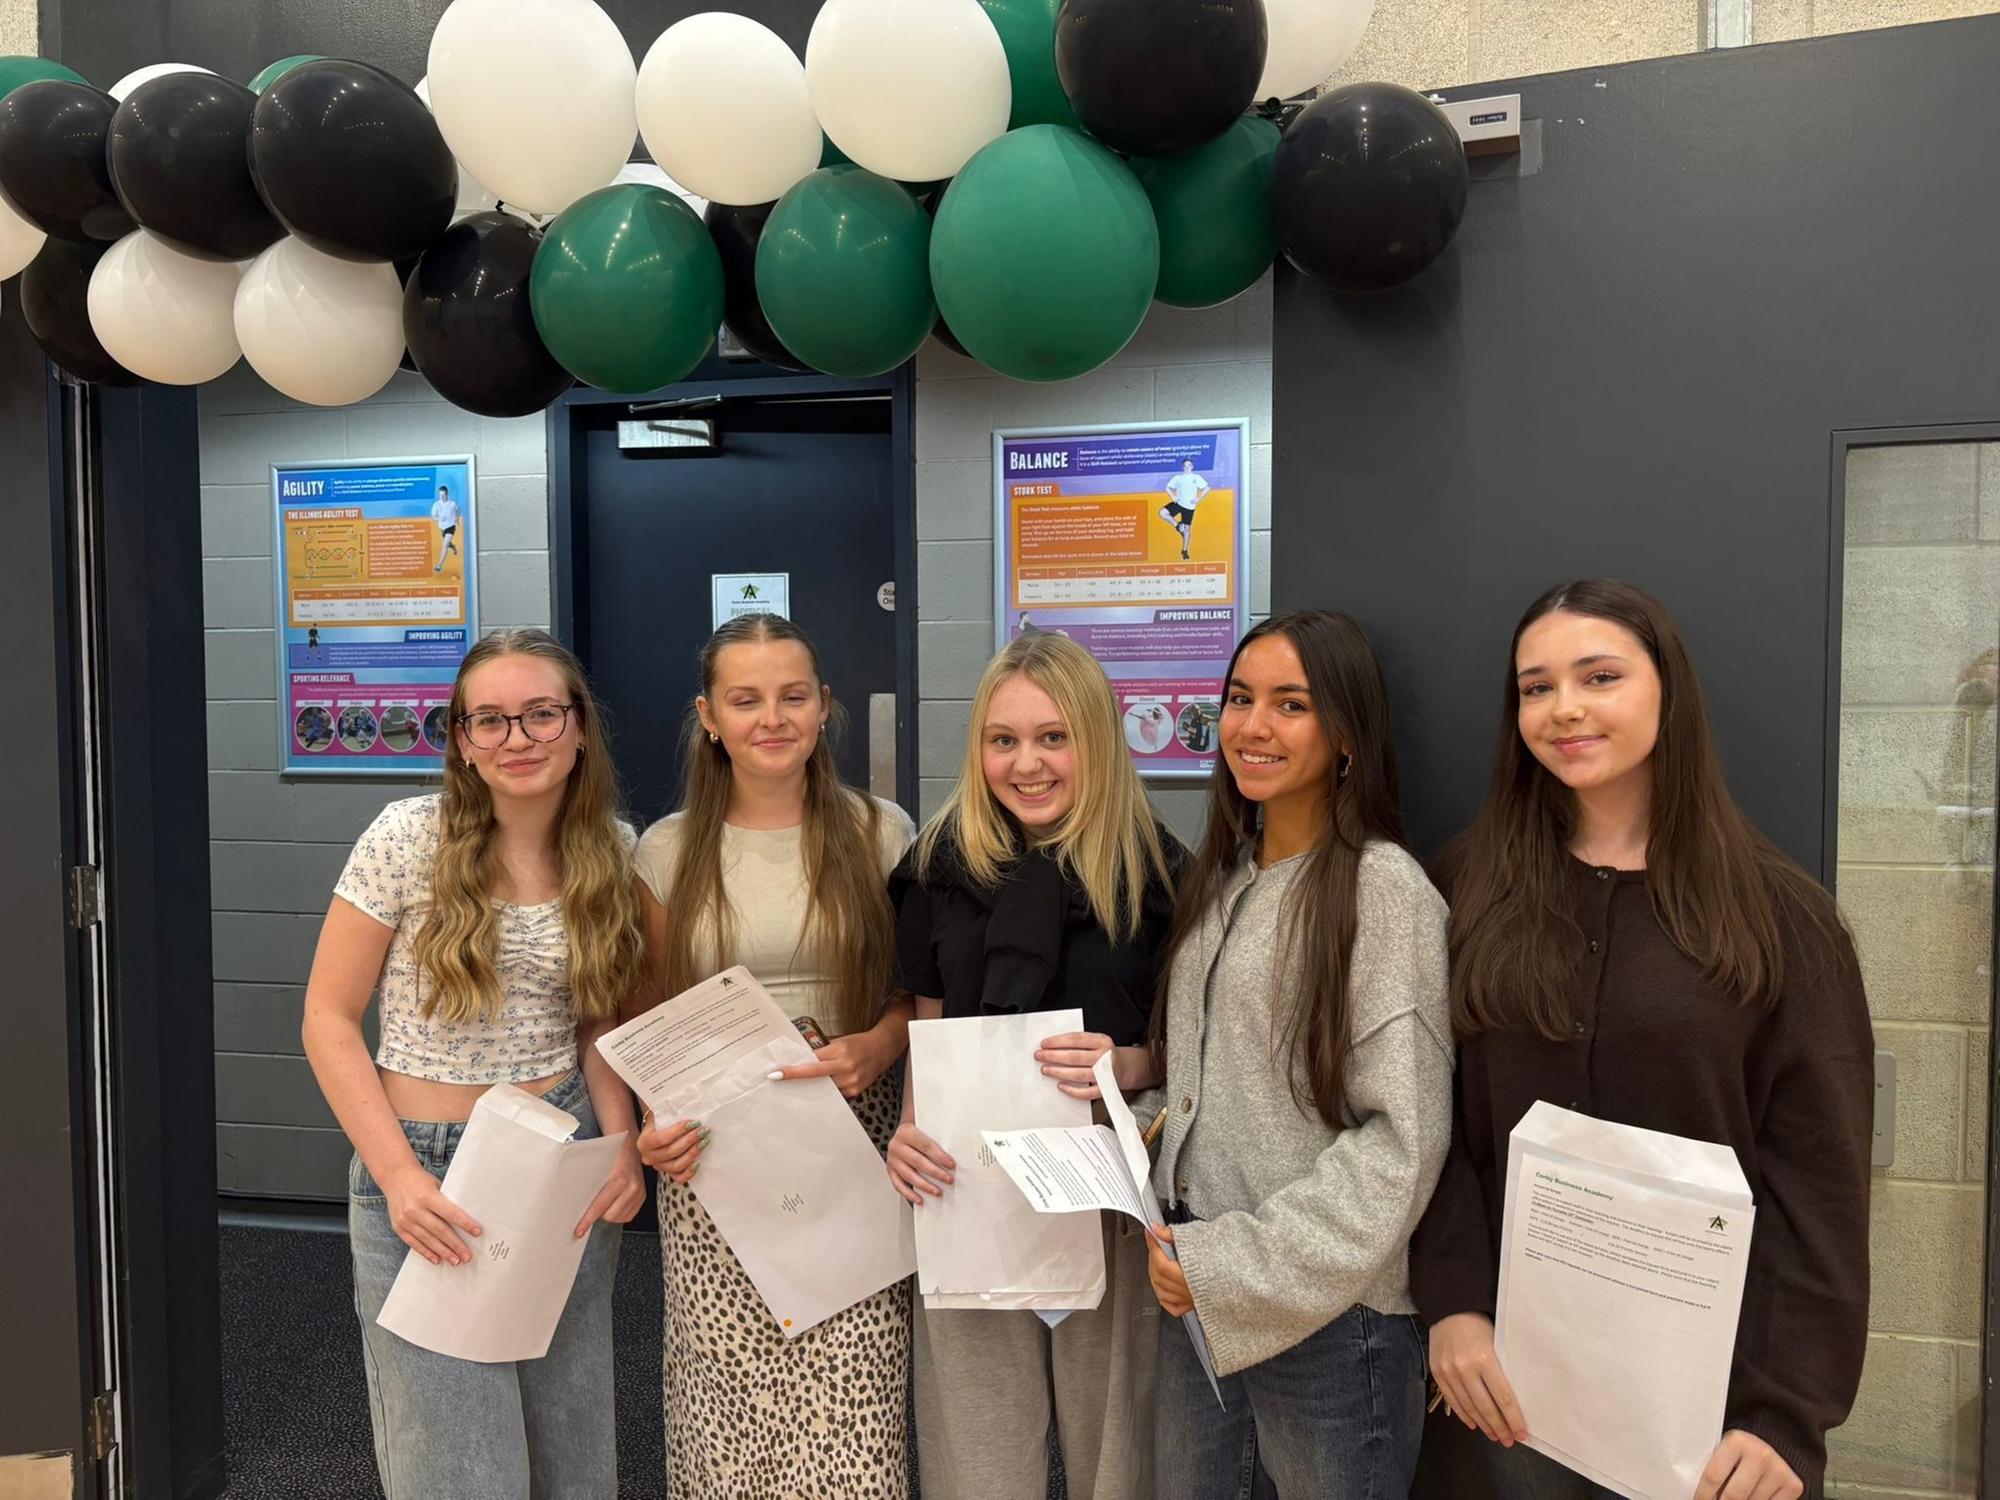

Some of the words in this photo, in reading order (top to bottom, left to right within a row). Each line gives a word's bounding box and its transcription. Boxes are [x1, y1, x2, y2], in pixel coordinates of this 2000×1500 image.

[1010, 452, 1068, 470] BALANCE
[284, 480, 324, 496] AGILITY
[1014, 486, 1035, 496] STORK
[1036, 486, 1052, 494] TEST
[1160, 612, 1199, 621] IMPROVING
[1200, 610, 1231, 620] BALANCE
[441, 631, 463, 640] AGILITY
[1536, 1172, 1553, 1182] Corby
[1554, 1178, 1582, 1191] Business
[1583, 1187, 1614, 1201] Academy
